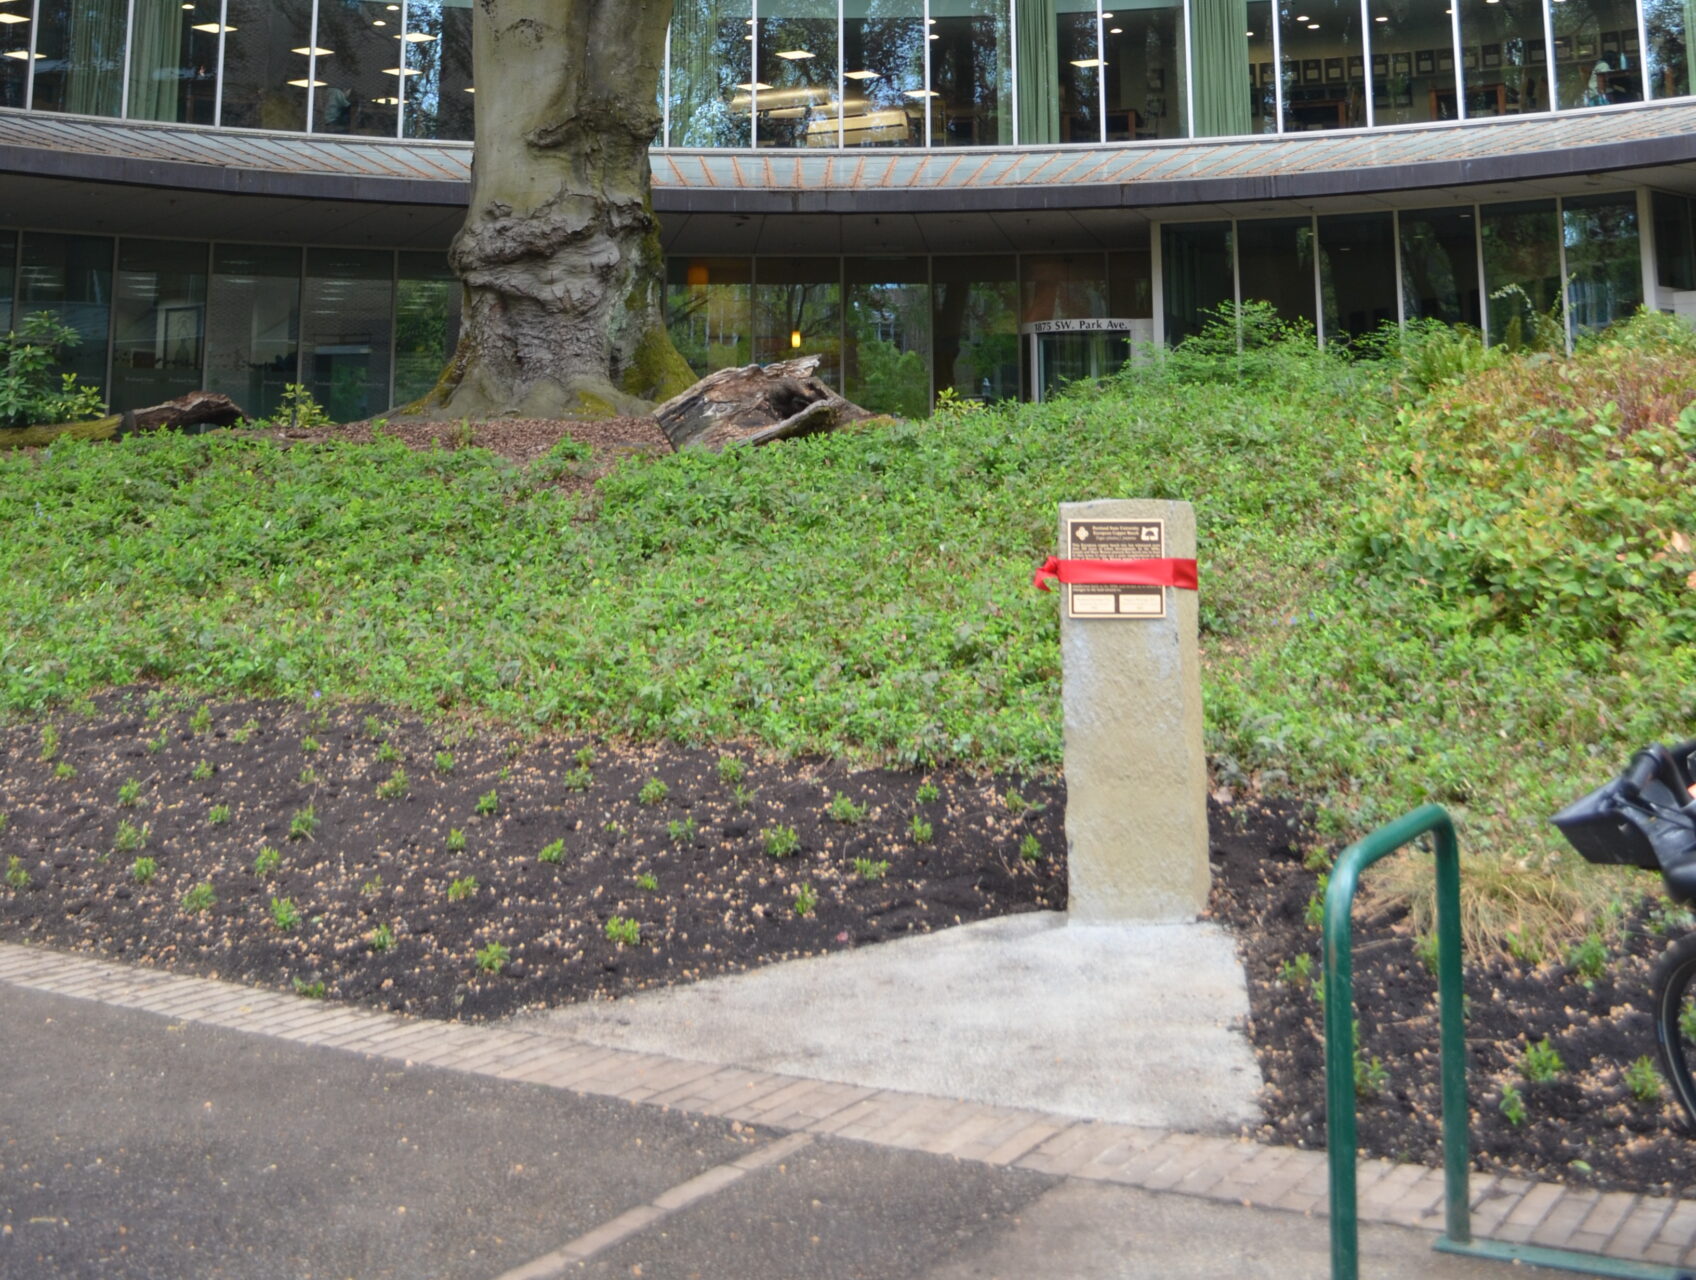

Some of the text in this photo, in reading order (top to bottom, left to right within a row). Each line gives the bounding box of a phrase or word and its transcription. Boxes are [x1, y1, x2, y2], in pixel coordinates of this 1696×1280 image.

[1035, 323, 1051, 331] 1875
[1079, 320, 1102, 329] Park
[1106, 320, 1128, 329] Ave.
